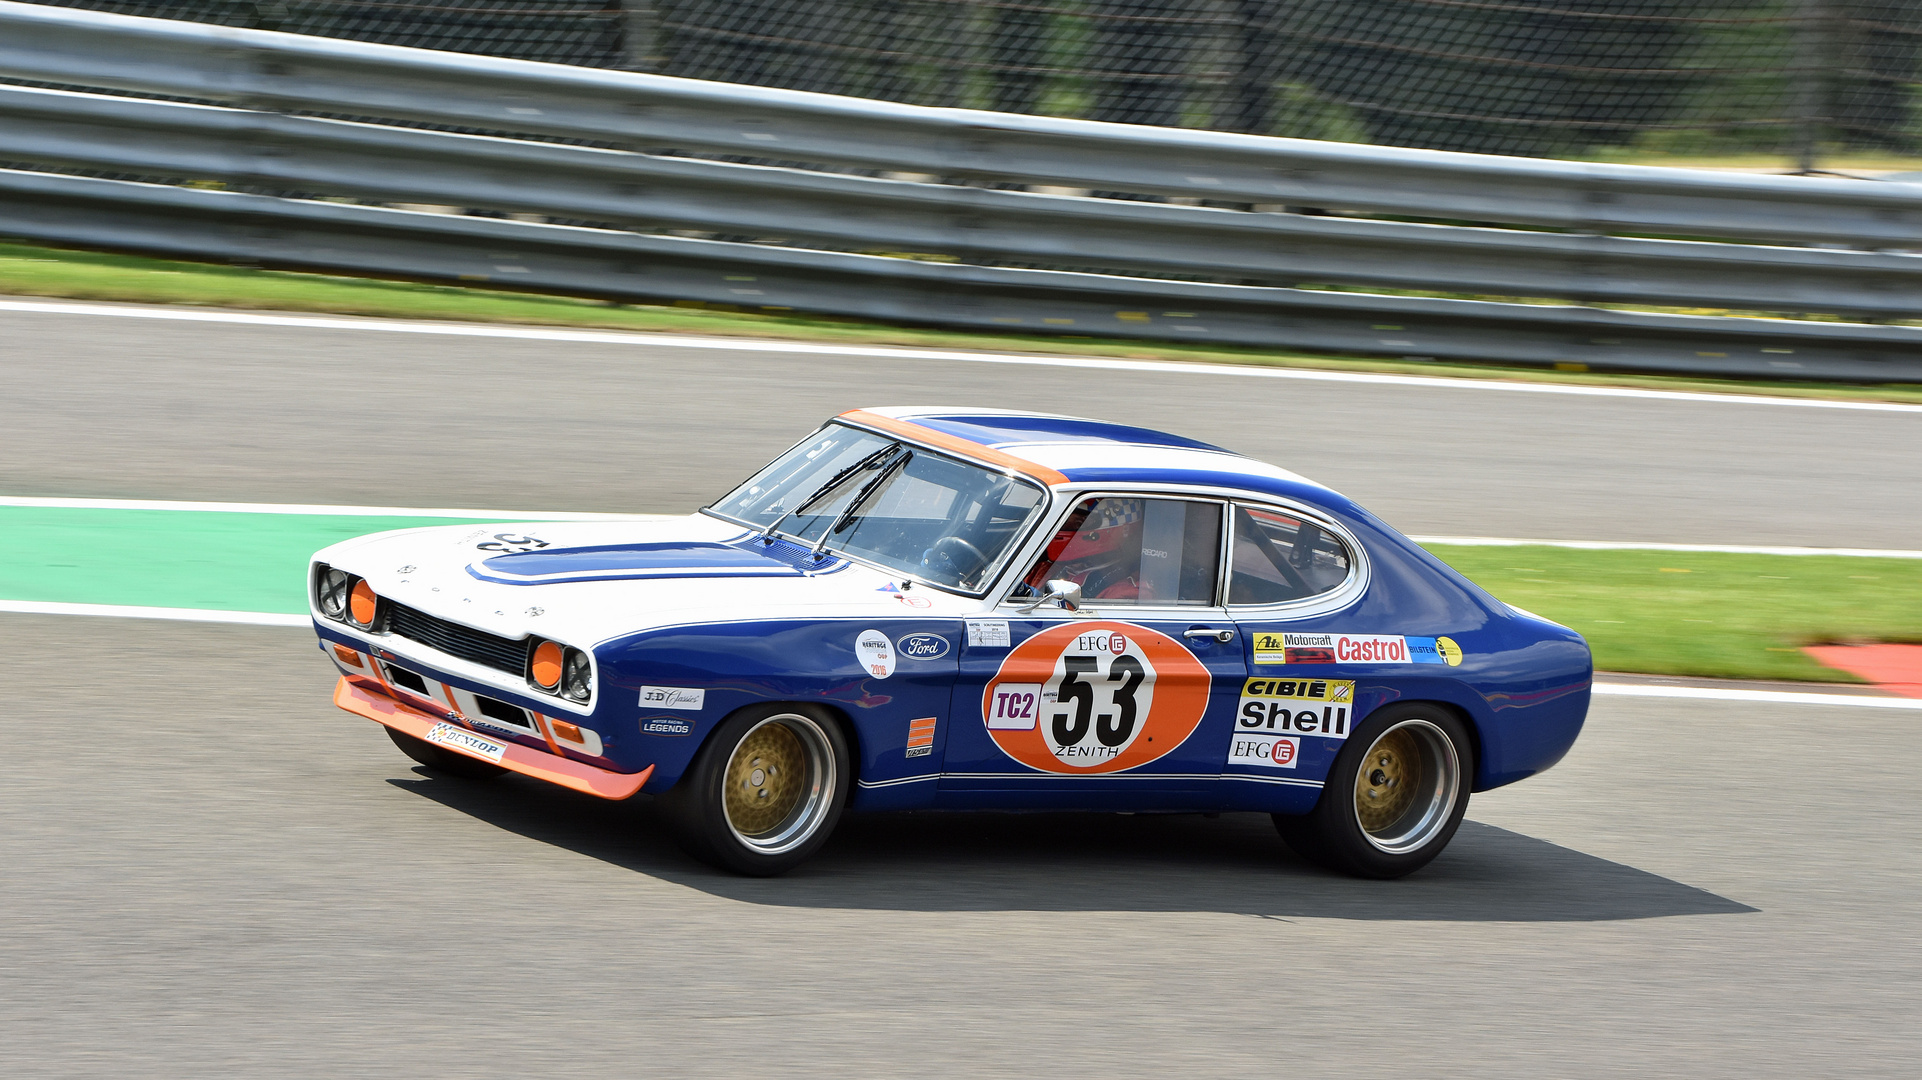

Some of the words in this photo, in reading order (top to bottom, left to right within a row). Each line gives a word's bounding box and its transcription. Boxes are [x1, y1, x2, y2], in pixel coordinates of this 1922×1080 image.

[907, 637, 939, 655] Ford
[1078, 636, 1108, 651] EFG
[1284, 634, 1333, 646] Motorcraft
[1337, 636, 1406, 661] Castrol
[870, 664, 887, 676] 2016
[1247, 680, 1327, 698] CIBIÉ
[997, 692, 1034, 718] TC2
[1052, 654, 1146, 747] 53
[1240, 701, 1346, 735] Shell
[643, 723, 689, 733] LEGENDS
[446, 731, 498, 754] DUNLOP
[1055, 746, 1119, 757] ZENITH
[1233, 741, 1270, 758] EFG
